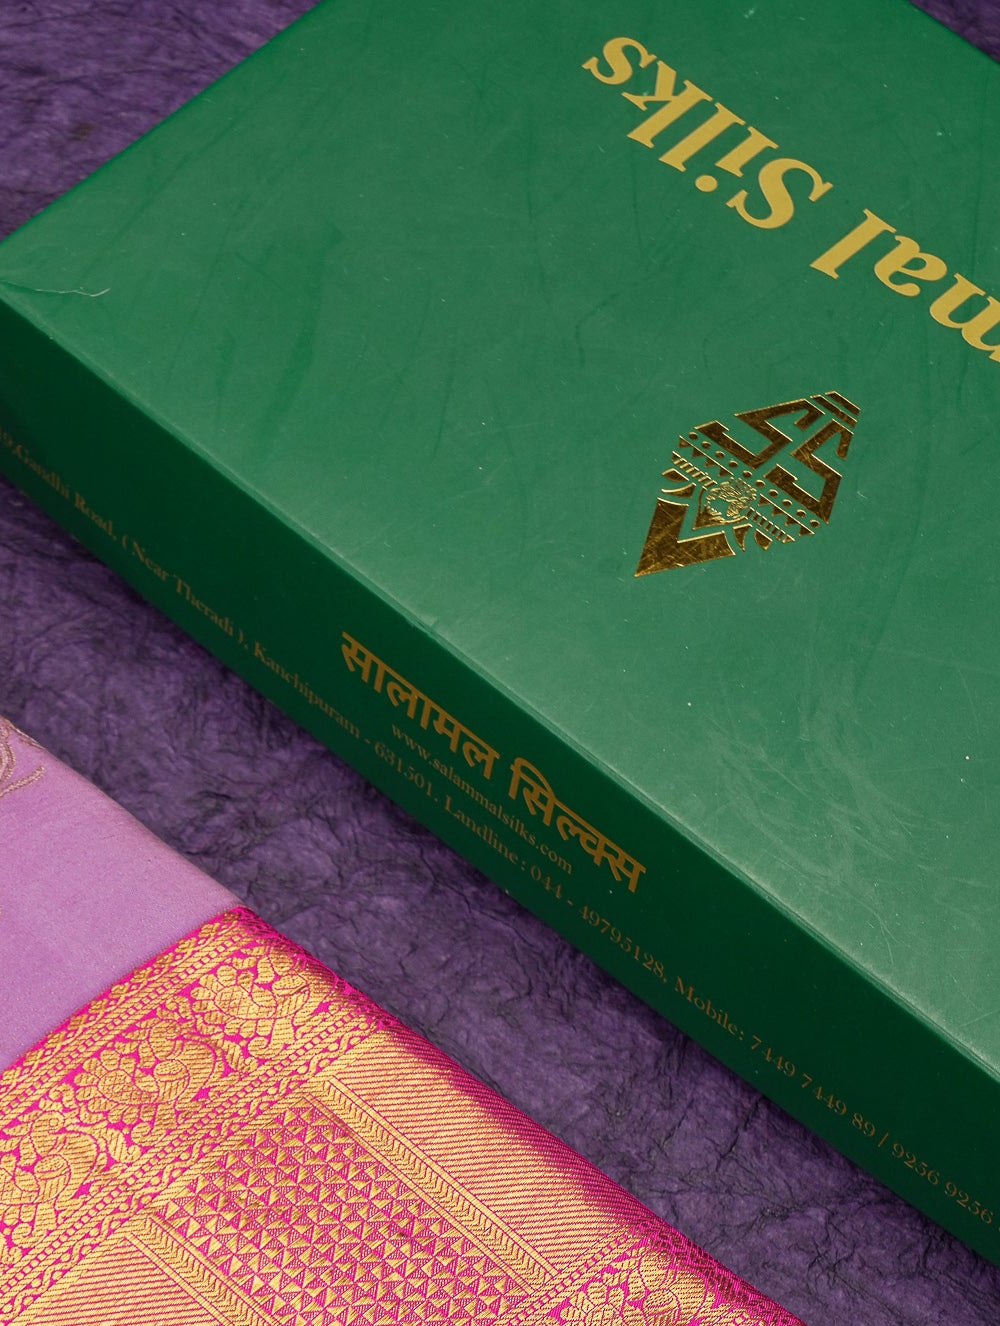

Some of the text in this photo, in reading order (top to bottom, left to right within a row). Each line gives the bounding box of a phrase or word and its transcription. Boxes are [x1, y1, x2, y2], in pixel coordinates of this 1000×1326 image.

[582, 37, 833, 229] Silks
[341, 631, 646, 893] सालामल सिल्क्स
[391, 723, 574, 875] www.salammalsilks.com
[132, 541, 169, 582] Near
[253, 641, 360, 739] Kanchipuram
[530, 864, 563, 899] 044
[750, 1034, 797, 1079] 7449
[801, 1073, 847, 1116] 7449
[851, 1111, 876, 1137] 89
[891, 1142, 941, 1186] 9256
[945, 1181, 994, 1225] 9256
